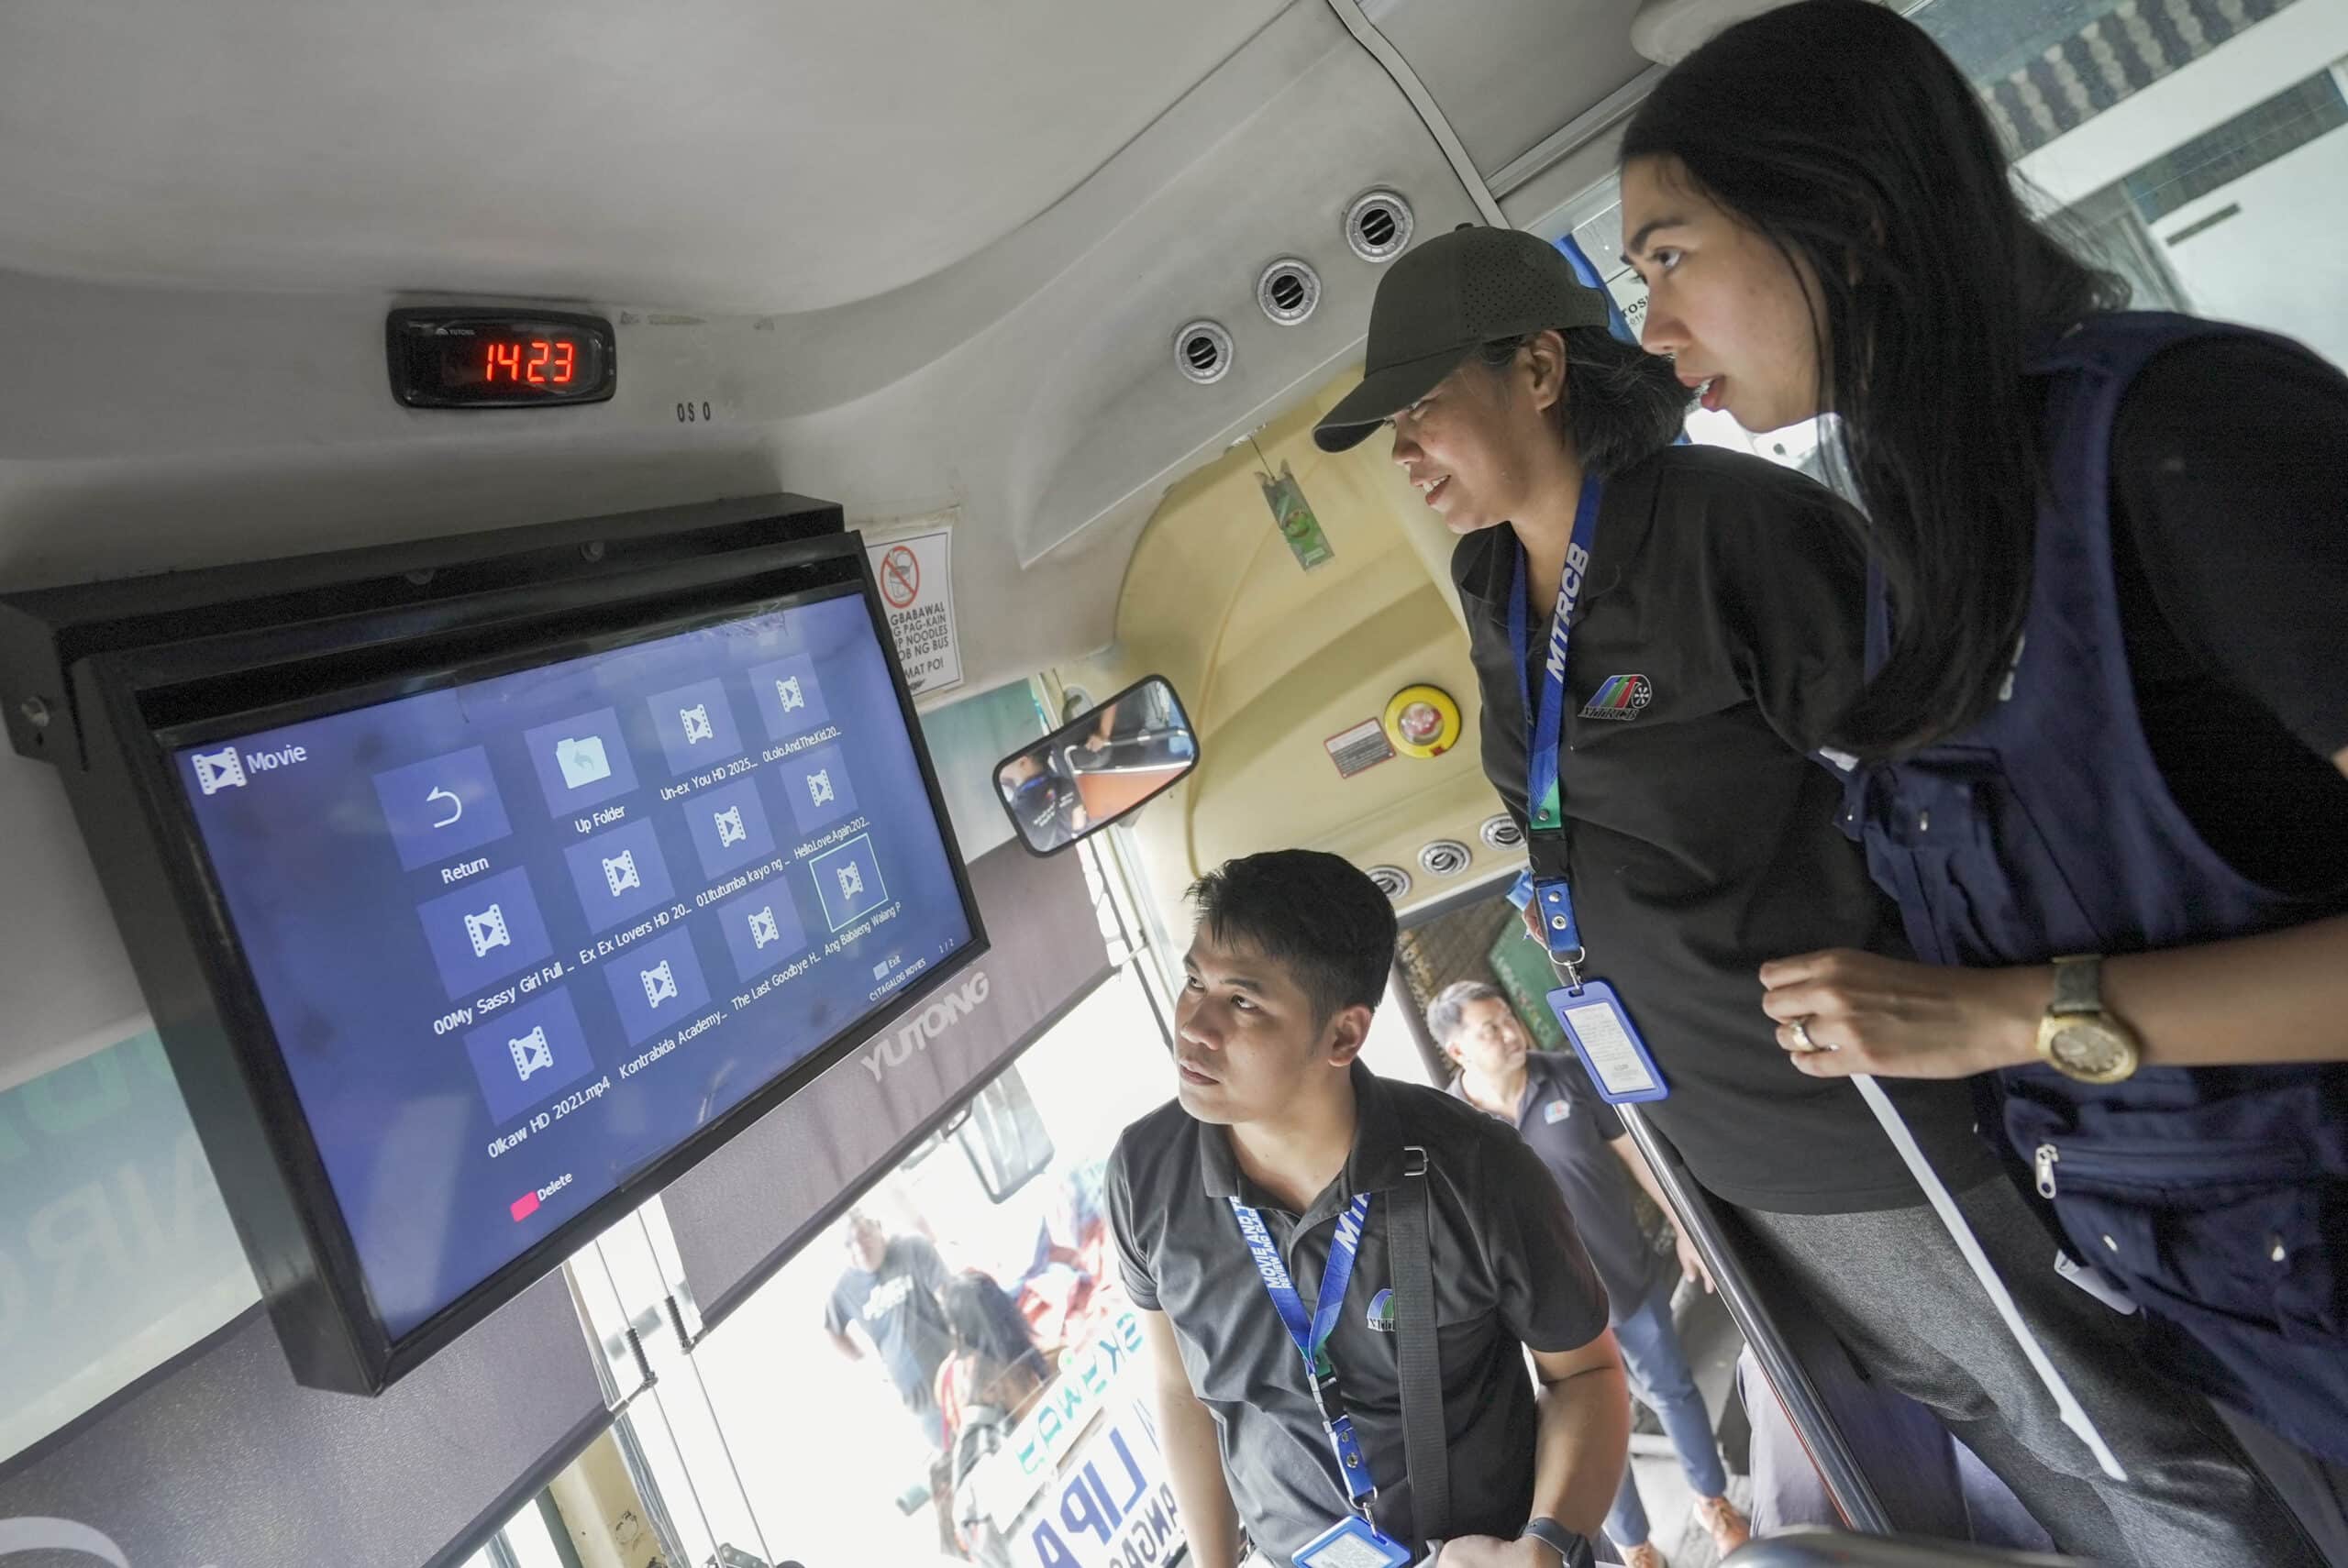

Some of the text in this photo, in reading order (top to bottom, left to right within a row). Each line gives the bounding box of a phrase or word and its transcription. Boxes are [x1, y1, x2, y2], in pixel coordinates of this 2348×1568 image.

[485, 342, 575, 383] 1423
[890, 602, 945, 626] GBABAWAL
[1545, 542, 1590, 684] MTRCB
[906, 624, 948, 646] NOODLES
[914, 642, 930, 657] NG
[932, 636, 949, 652] BUS
[246, 744, 307, 774] Movie
[659, 782, 691, 801] Un-ex
[692, 772, 712, 791] You
[712, 767, 726, 786] HD
[575, 804, 626, 834] Up Folder
[441, 856, 490, 884] Return
[748, 865, 771, 886] kayo
[770, 858, 783, 877] ng
[580, 947, 596, 966] Ex
[597, 938, 615, 956] Ex
[615, 918, 653, 948] Lovers
[653, 911, 670, 929] HD
[824, 940, 841, 956] Ang
[839, 922, 871, 945] Babaeng
[870, 906, 896, 928] Walang
[887, 955, 902, 969] Exit
[476, 985, 515, 1014] Sassy
[519, 972, 541, 993] Girl
[541, 962, 563, 983] Full
[731, 990, 751, 1012] The
[749, 979, 771, 1001] Last
[771, 959, 809, 988] Goodbye
[861, 971, 991, 1082] YUTONG
[618, 1038, 677, 1080] Kontrabida
[529, 1111, 551, 1133] HD
[551, 1076, 612, 1121] 2021.mp4
[537, 1171, 573, 1202] Delete
[1250, 1246, 1283, 1289] MOVIE
